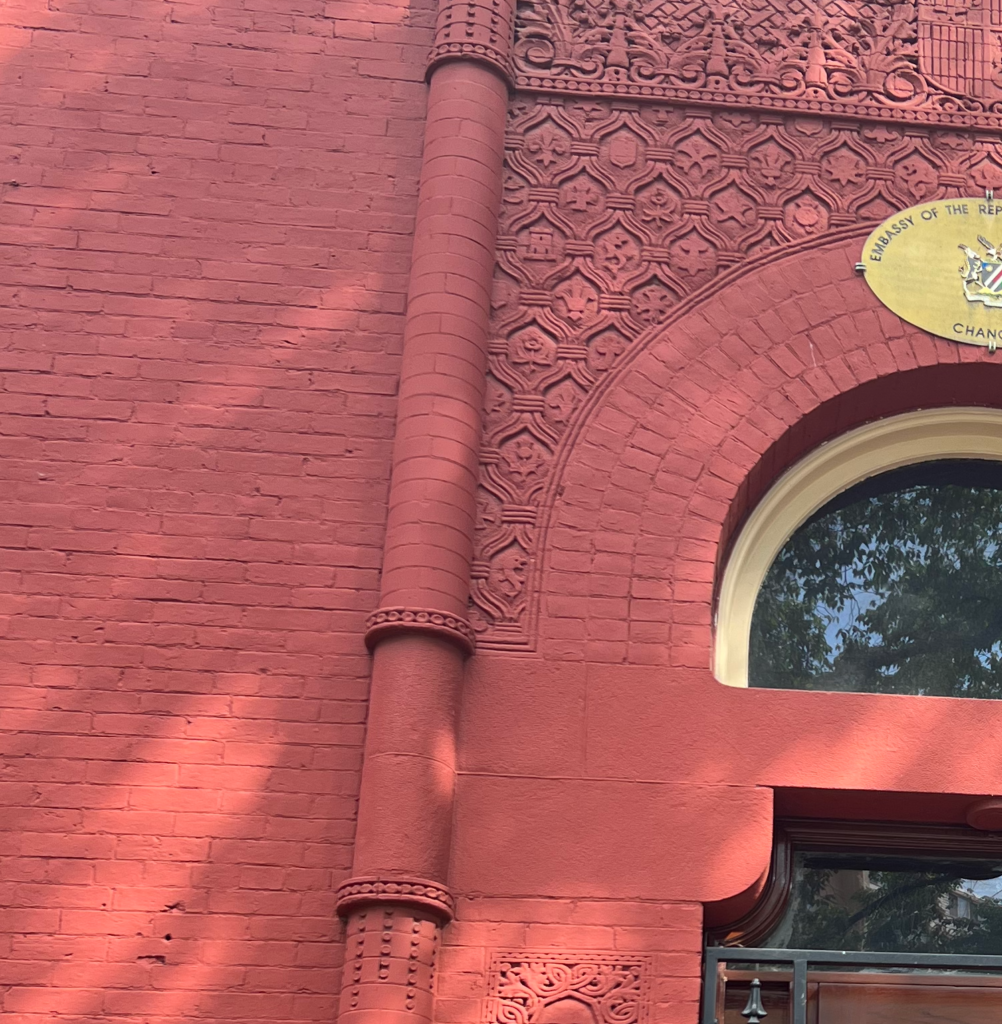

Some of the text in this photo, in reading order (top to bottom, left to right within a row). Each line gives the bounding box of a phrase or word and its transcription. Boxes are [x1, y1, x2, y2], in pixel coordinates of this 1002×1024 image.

[870, 216, 915, 262] EMBASSY
[920, 208, 939, 221] OF
[945, 204, 969, 215] THE
